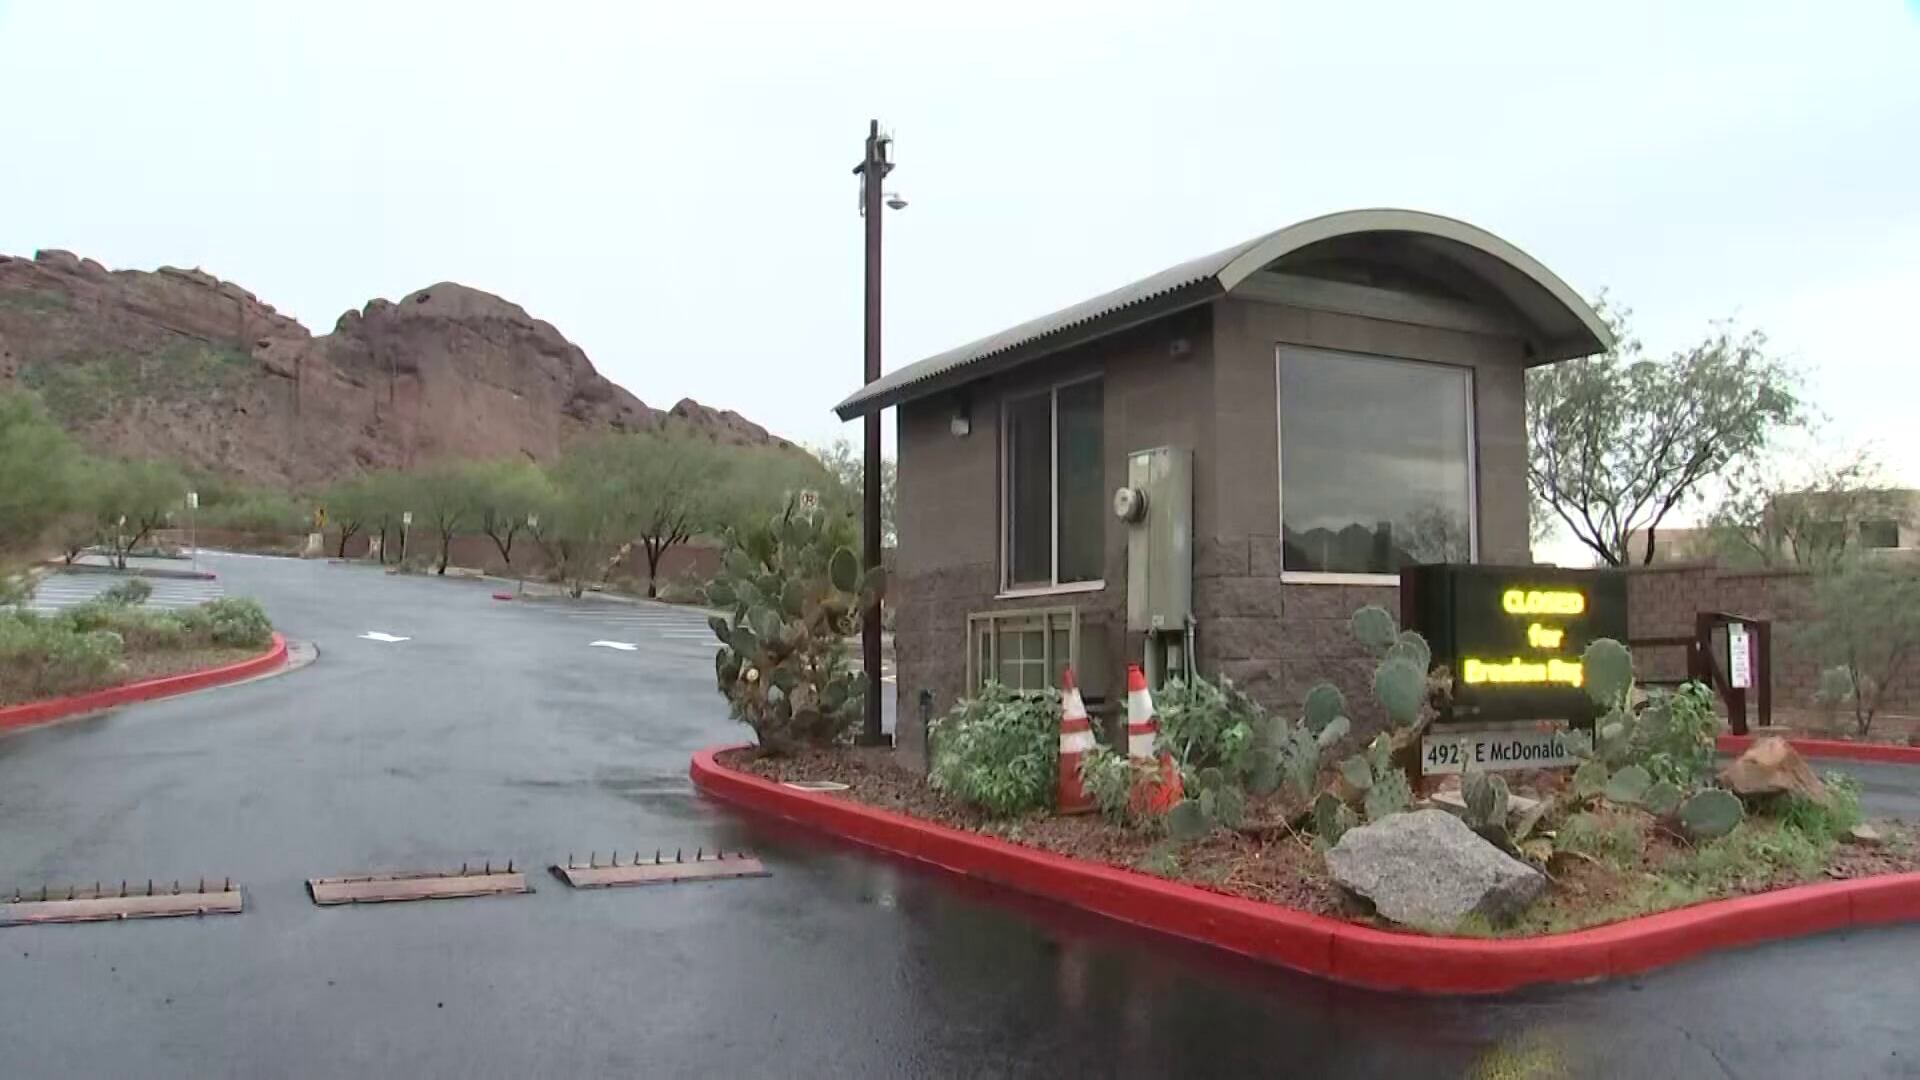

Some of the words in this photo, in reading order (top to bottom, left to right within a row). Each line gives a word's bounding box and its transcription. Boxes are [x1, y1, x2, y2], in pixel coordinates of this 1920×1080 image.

[1503, 590, 1584, 614] CLOSED
[1528, 623, 1563, 648] for
[1428, 743, 1467, 765] 492
[1475, 743, 1486, 762] E
